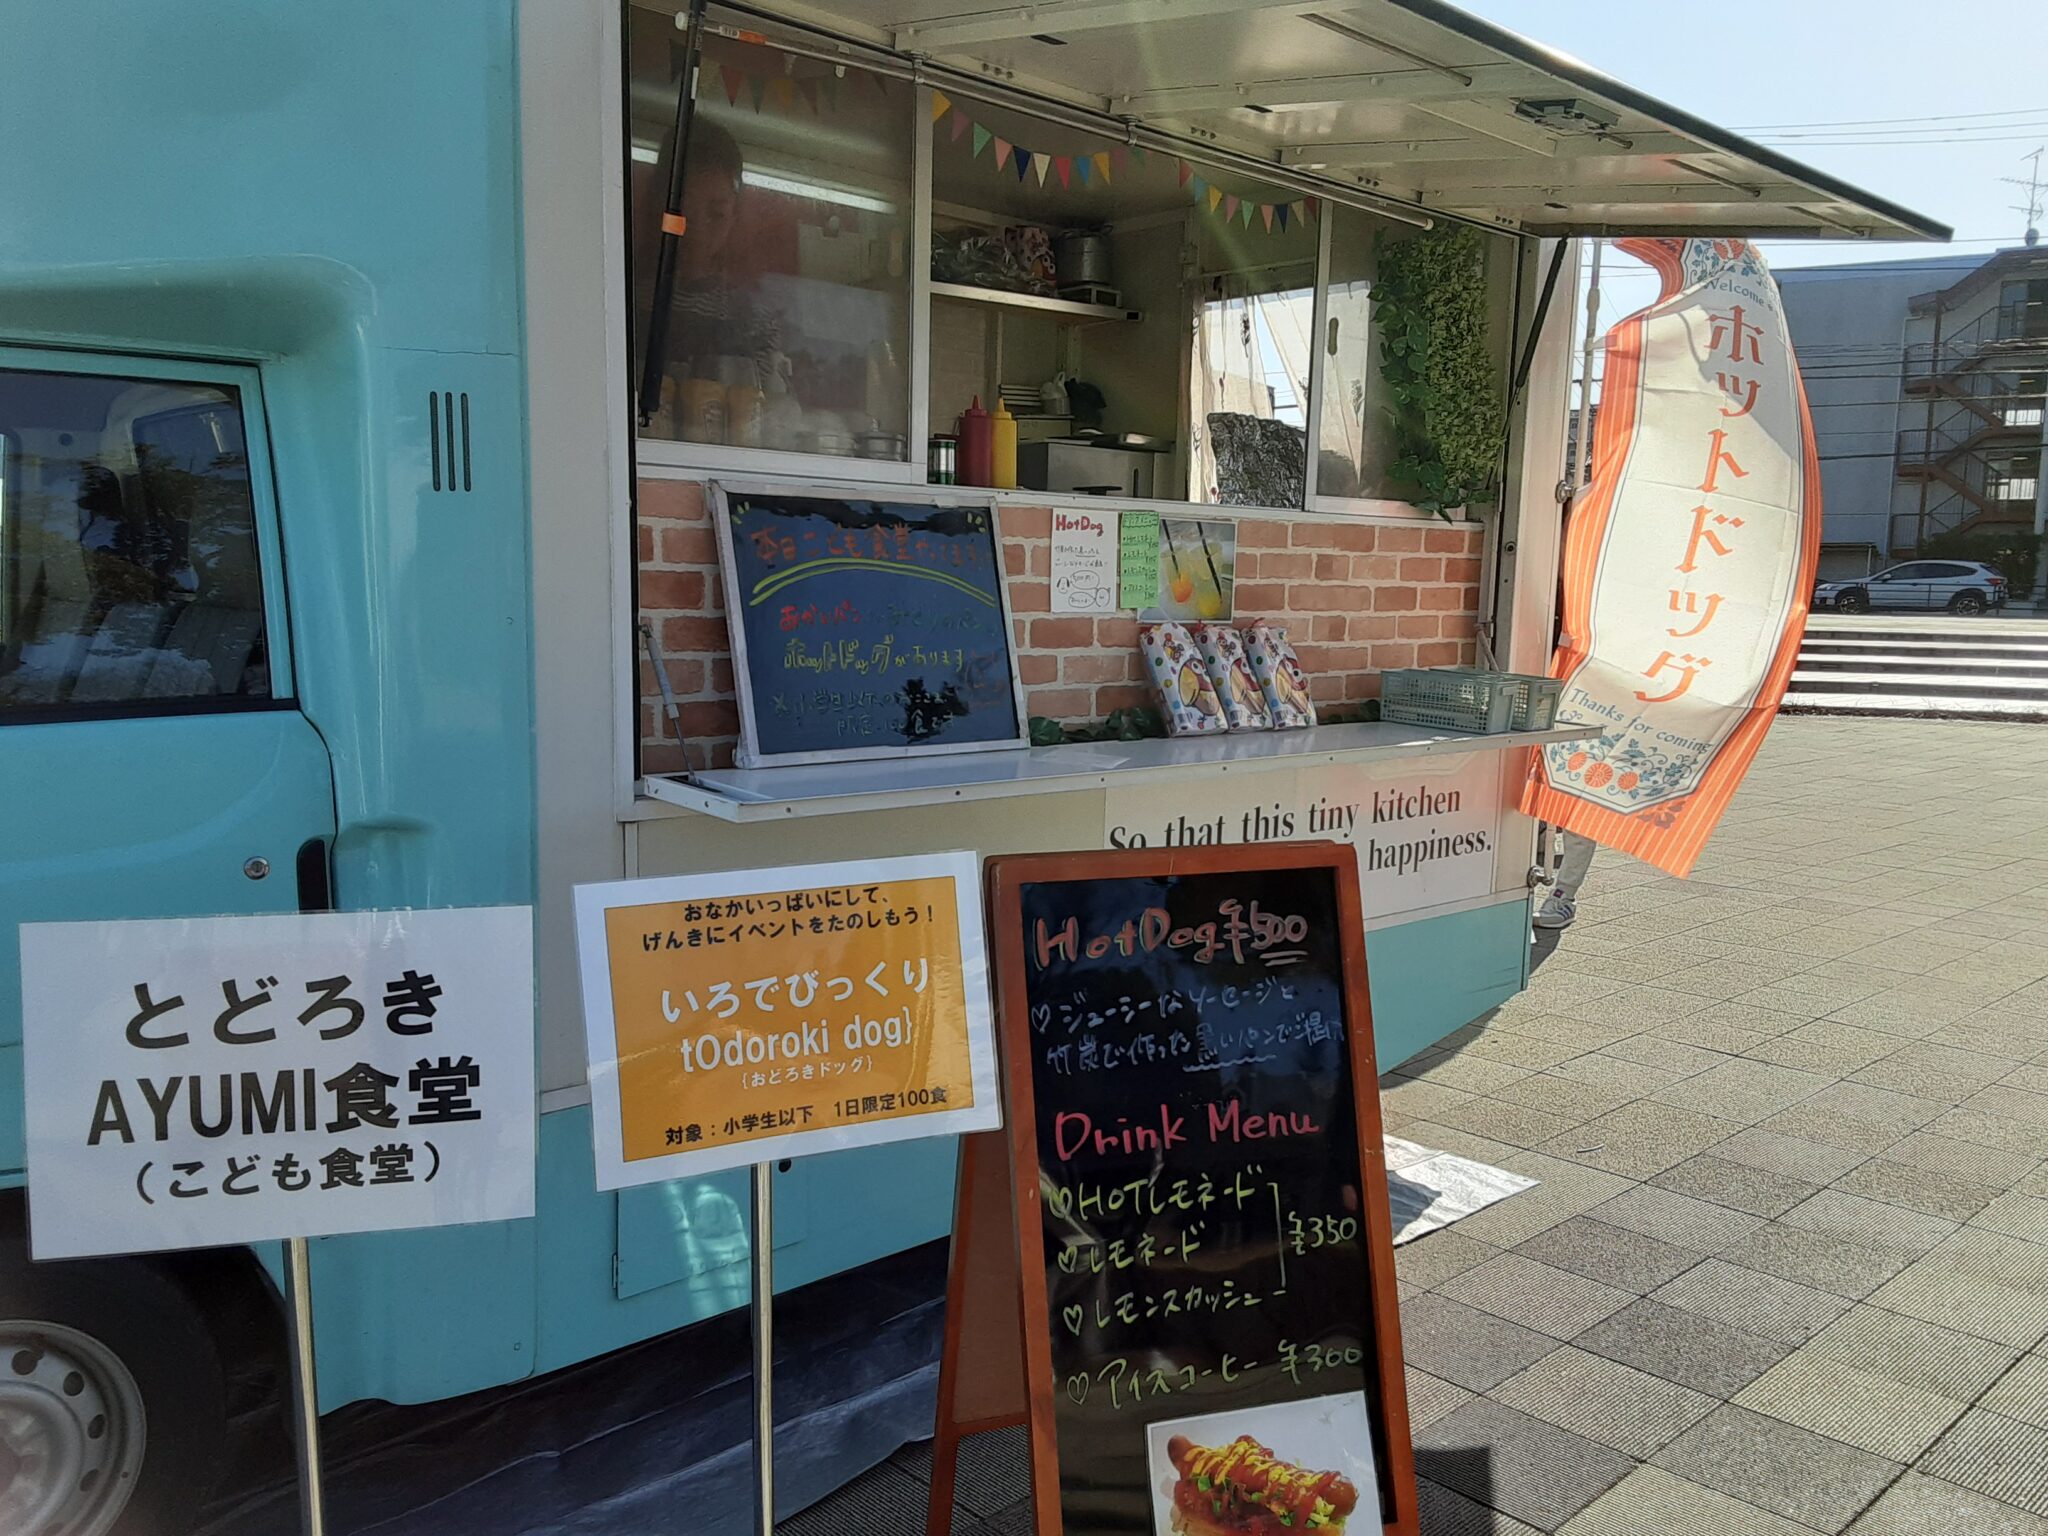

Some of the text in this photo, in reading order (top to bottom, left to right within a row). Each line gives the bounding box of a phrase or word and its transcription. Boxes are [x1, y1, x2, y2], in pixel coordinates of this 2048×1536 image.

[1703, 276, 1765, 307] Welcome
[1055, 513, 1104, 537] HotDog
[1632, 304, 1766, 704] ホットドッグ
[1569, 688, 1715, 755] Thanks for coming
[1163, 815, 1226, 847] that
[1241, 803, 1295, 843] this
[1308, 797, 1360, 838] tiny
[1371, 784, 1462, 825] kitchen
[1367, 827, 1492, 876] happiness.
[1033, 907, 1225, 971] HotDog
[125, 969, 443, 1049] とどろき
[661, 957, 930, 1024] いろでびっくり
[680, 1019, 830, 1073] tOdoroki
[86, 1055, 482, 1146] AYUMI食堂
[1054, 1099, 1321, 1161] Drink Menu
[1078, 1164, 1263, 1222] HOTレモネード
[1089, 1221, 1206, 1273] レモネード
[1096, 1281, 1263, 1329] レモンスカッシュ
[1097, 1353, 1258, 1410] アイスコーヒー
